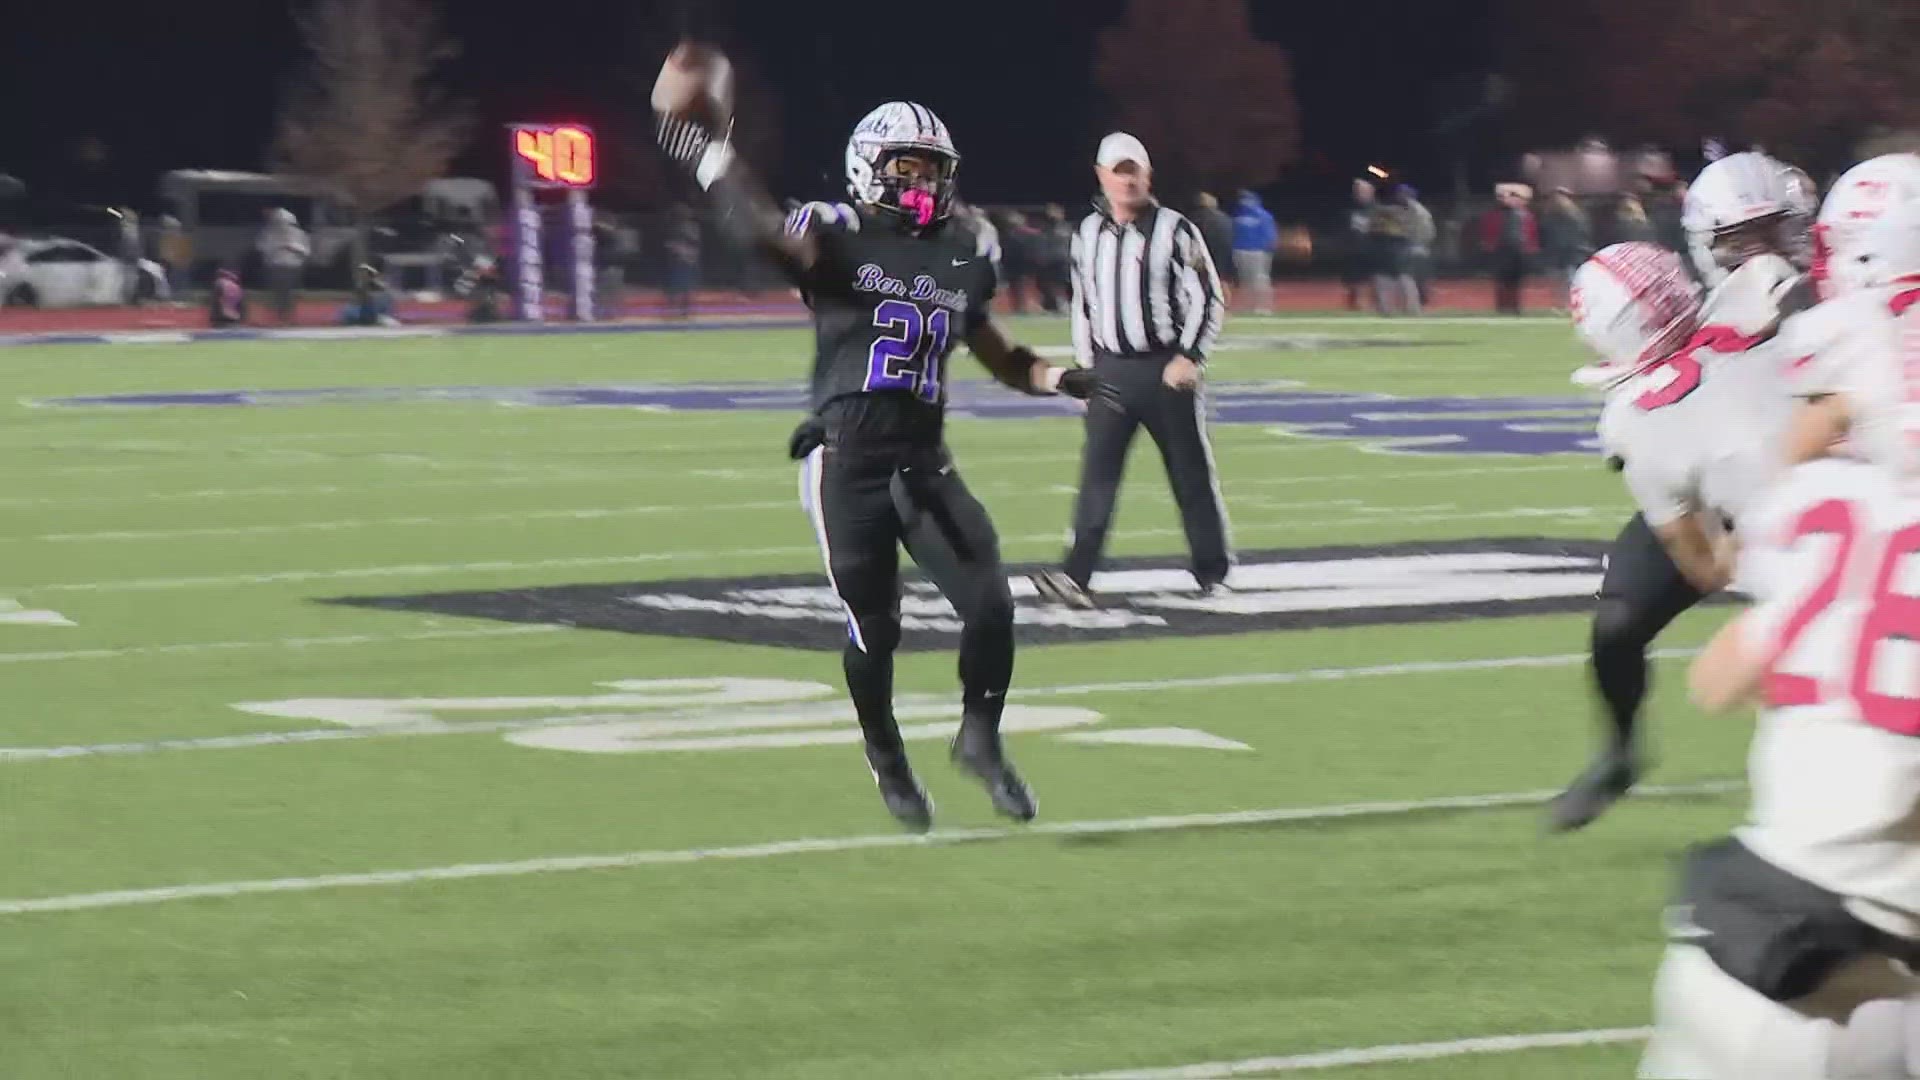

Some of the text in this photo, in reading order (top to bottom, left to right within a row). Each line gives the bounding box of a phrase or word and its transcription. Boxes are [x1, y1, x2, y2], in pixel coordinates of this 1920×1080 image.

[516, 128, 593, 184] 40
[852, 263, 907, 297] Ben
[862, 299, 949, 403] 21
